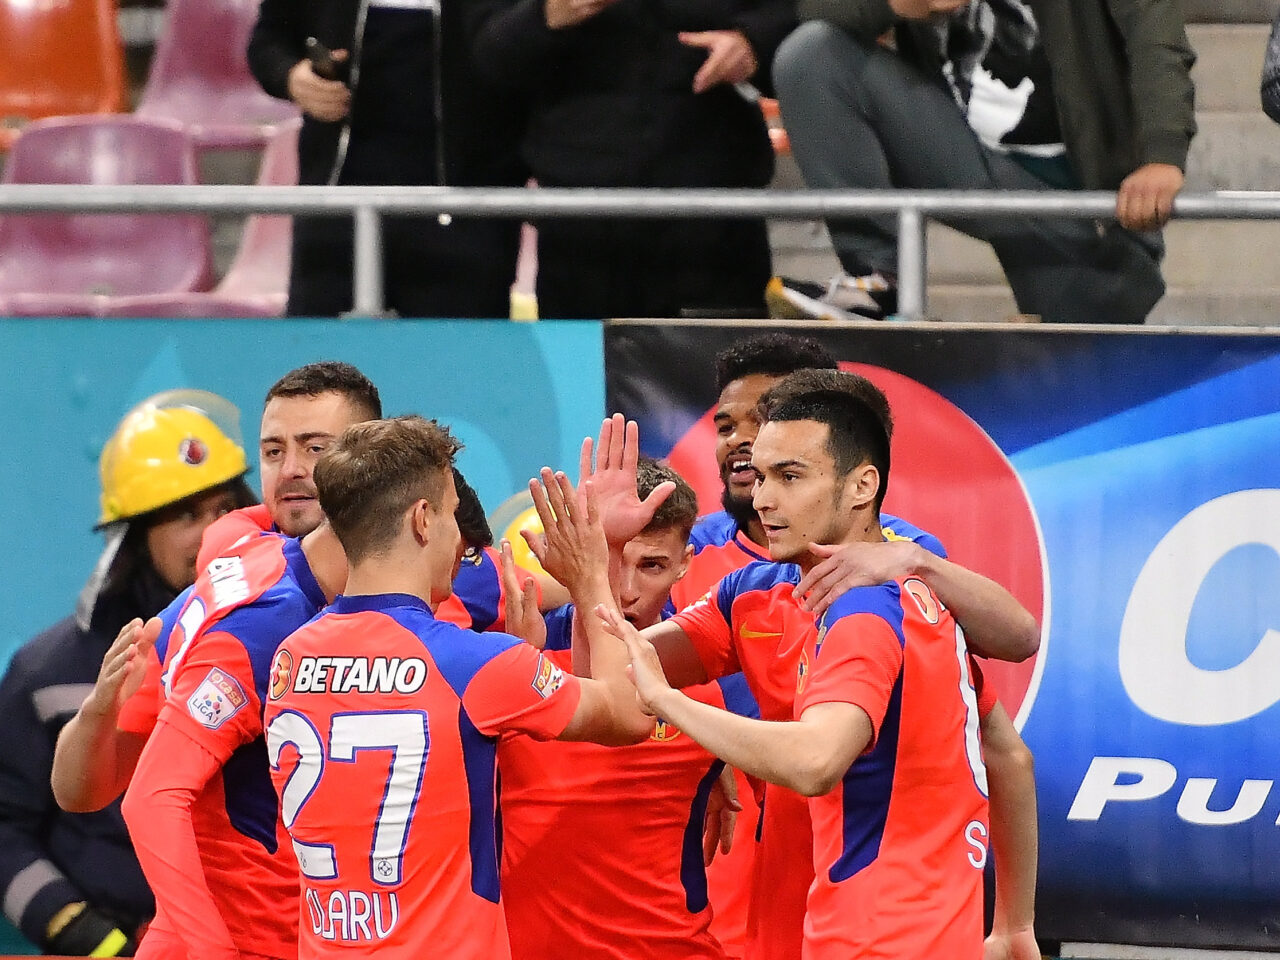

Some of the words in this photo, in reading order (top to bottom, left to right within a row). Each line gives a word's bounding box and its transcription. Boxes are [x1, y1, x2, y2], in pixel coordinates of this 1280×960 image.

[293, 656, 427, 695] BETANO
[192, 698, 214, 721] LIGA
[267, 708, 429, 886] 27
[1067, 756, 1280, 826] Pu
